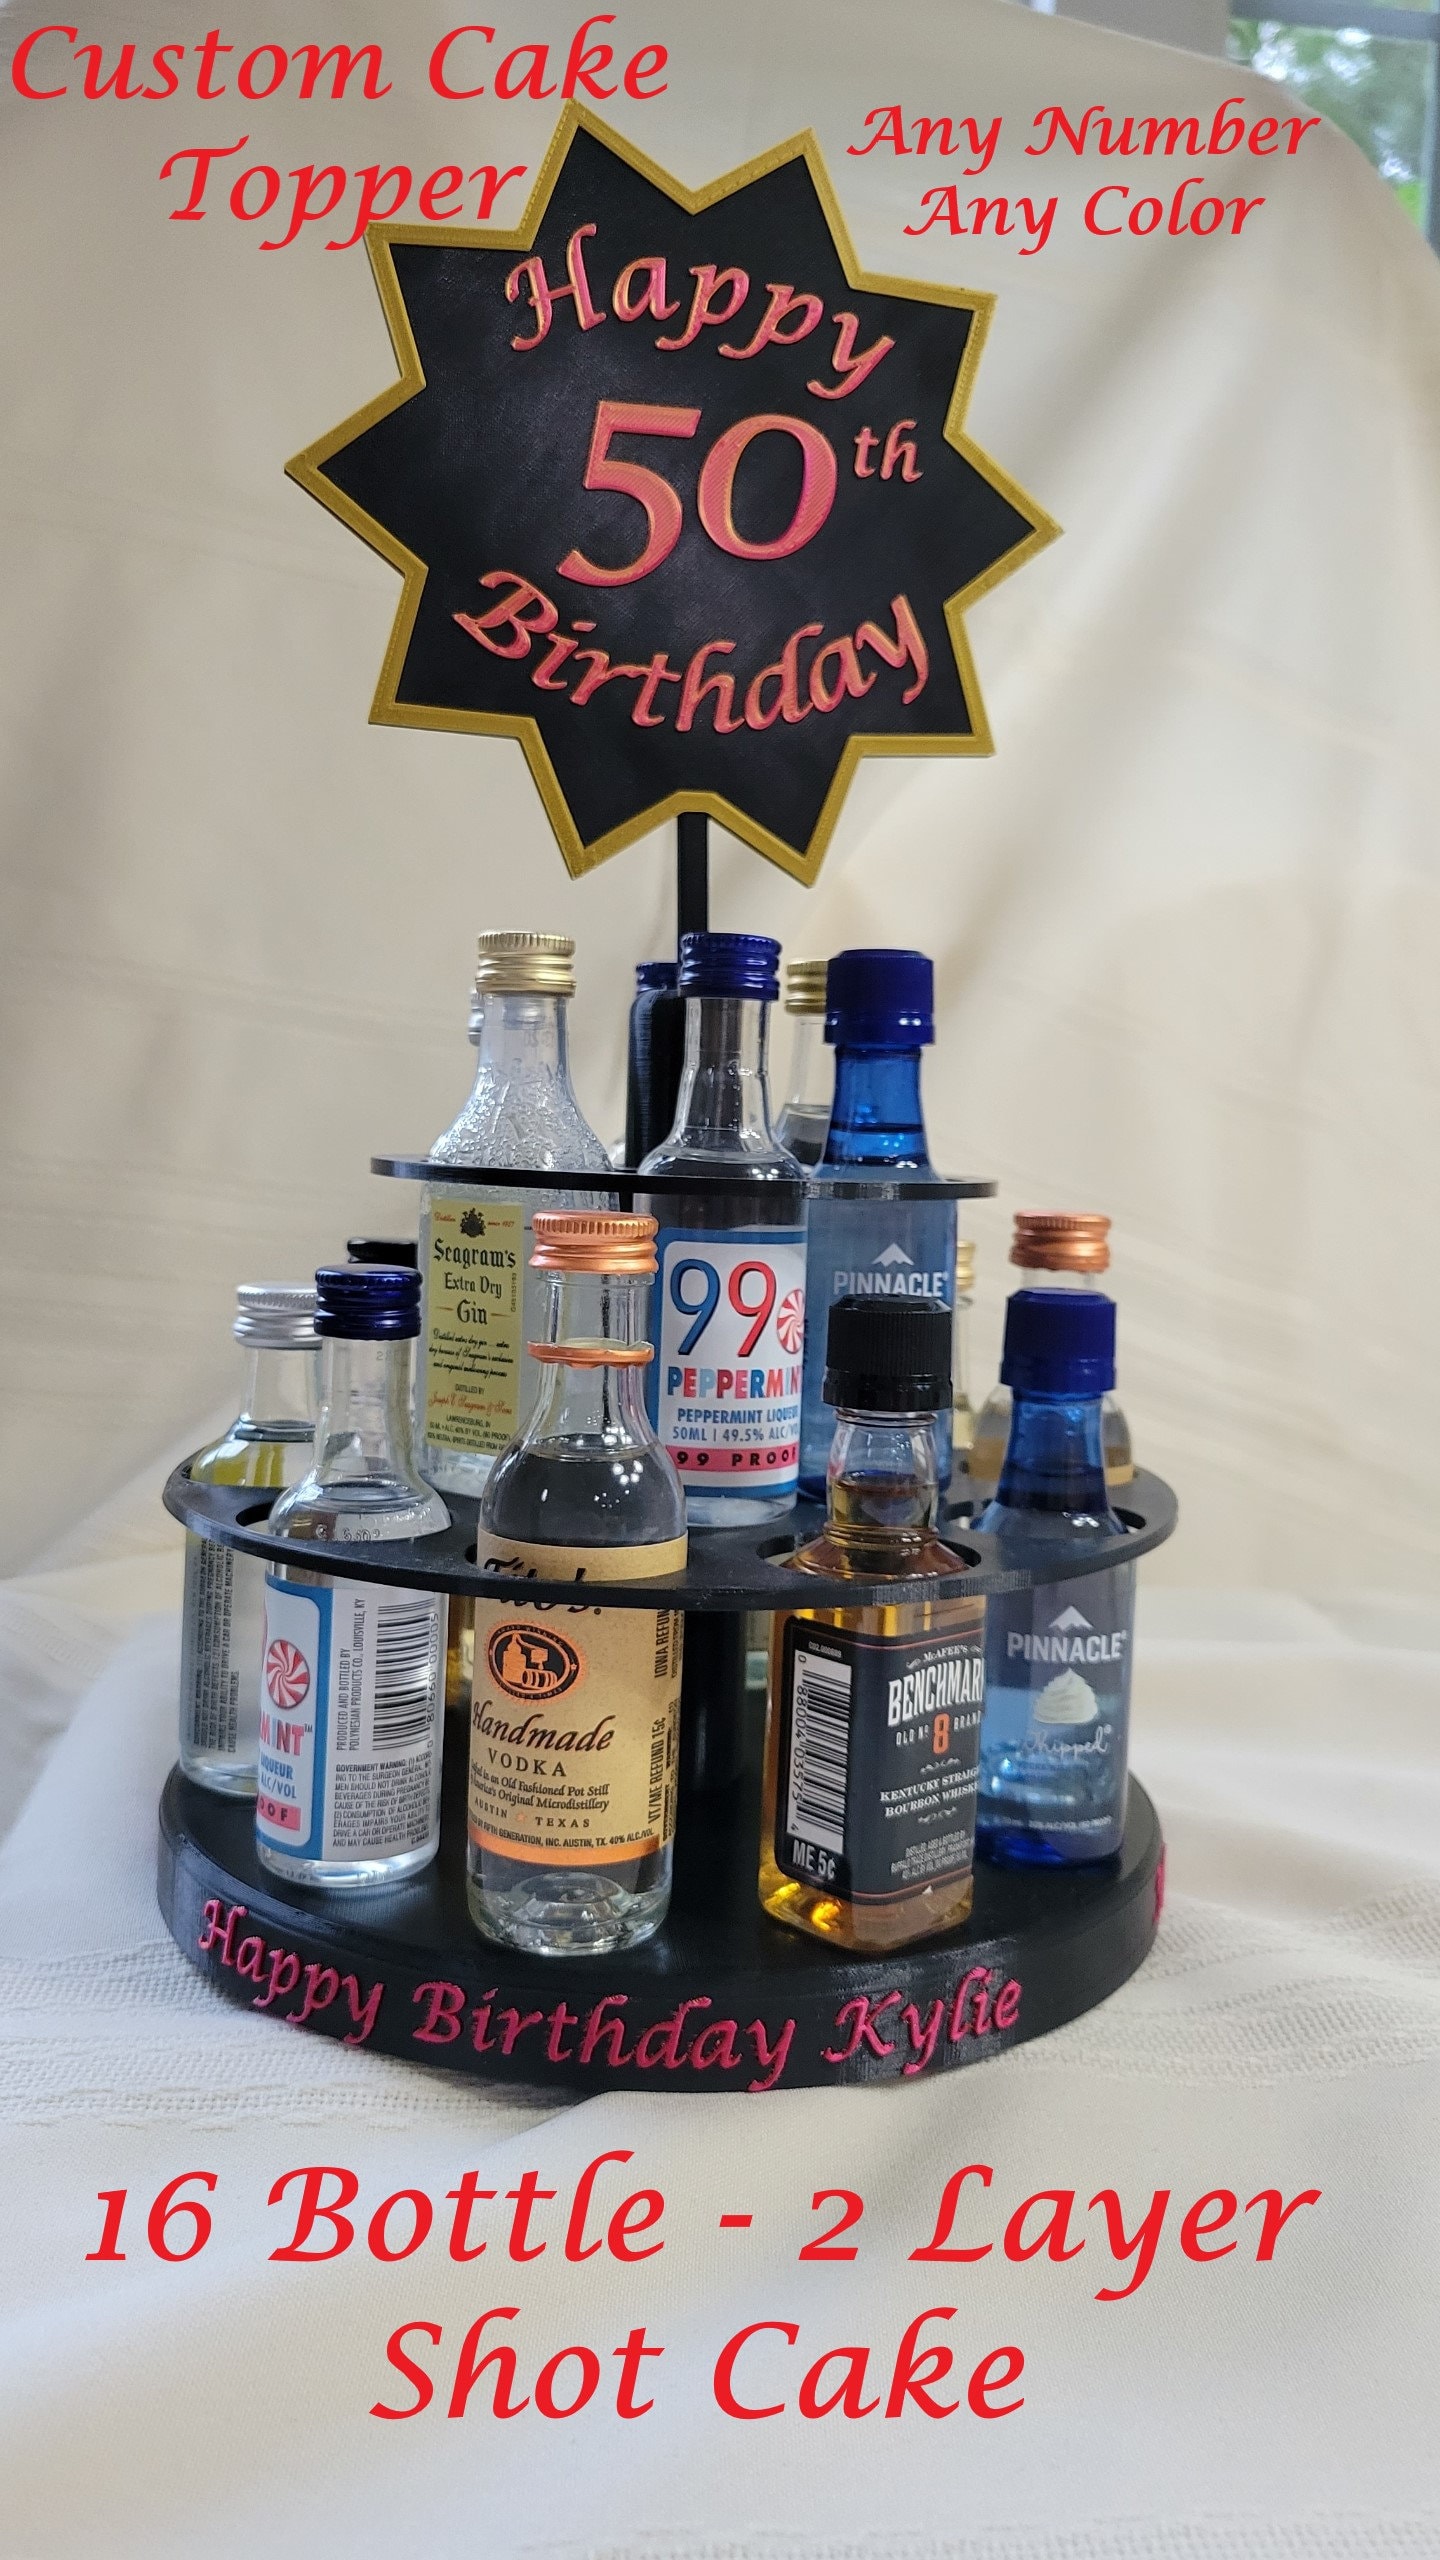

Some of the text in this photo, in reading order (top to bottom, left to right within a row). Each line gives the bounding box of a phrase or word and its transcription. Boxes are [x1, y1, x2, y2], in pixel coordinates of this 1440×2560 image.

[507, 223, 895, 400] Happy
[452, 595, 929, 734] Birthday
[433, 1238, 516, 1269] Seagram's
[444, 1272, 476, 1292] Extra
[480, 1275, 502, 1299] Dry
[834, 1270, 945, 1297] PINNACLE
[457, 1299, 487, 1325] Gin
[670, 1259, 777, 1358] 99
[667, 1365, 801, 1399] PEPPERMIN
[673, 1426, 707, 1441] 50ML
[722, 1428, 764, 1442] 49.5%
[769, 1423, 798, 1440] ALC/VO
[678, 1408, 763, 1424] PEPPERMINT
[354, 1598, 365, 1608] KY
[353, 1611, 366, 1651] LOUISVILLE,
[654, 1609, 670, 1678] IOWA REFUN
[1007, 1630, 1122, 1664] PINNACLE
[798, 1654, 807, 1663] 0
[336, 1648, 350, 1751] PRODUCED AND BOTTLED BY
[351, 1670, 362, 1705] PRODUCTS
[349, 1708, 361, 1751] POLYNESIAN
[472, 1700, 616, 1751] Handmade
[896, 1729, 915, 1746] OLD
[933, 1713, 950, 1755] 8
[792, 1685, 808, 1802] 88004 03575
[336, 1763, 378, 1772] GOVERNMENT
[359, 1773, 371, 1781] THE
[488, 1747, 567, 1777] VODKA
[648, 1717, 666, 1824] VT/ME REFUND 15¢
[378, 1780, 389, 1789] NOT
[498, 1789, 534, 1806] Original
[536, 1797, 610, 1812] Microdistillery
[501, 1777, 516, 1789] Old
[518, 1781, 565, 1796] Fashioned
[567, 1786, 585, 1797] Pot
[587, 1784, 610, 1796] Still
[880, 1767, 979, 1802] KENTUCKY STRAIG
[885, 1781, 978, 1818] BOURBON WHISK
[260, 1795, 288, 1821] OOF
[474, 1797, 590, 1828] AUSTIN TEXAS
[499, 1827, 543, 1846] GENERATION,
[545, 1837, 561, 1847] INC.
[563, 1837, 594, 1848] AUSTIN,
[609, 1835, 625, 1845] 40%
[792, 1839, 836, 1881] ME 5¢
[198, 1898, 1023, 2092] Happy Birthday Kylie
